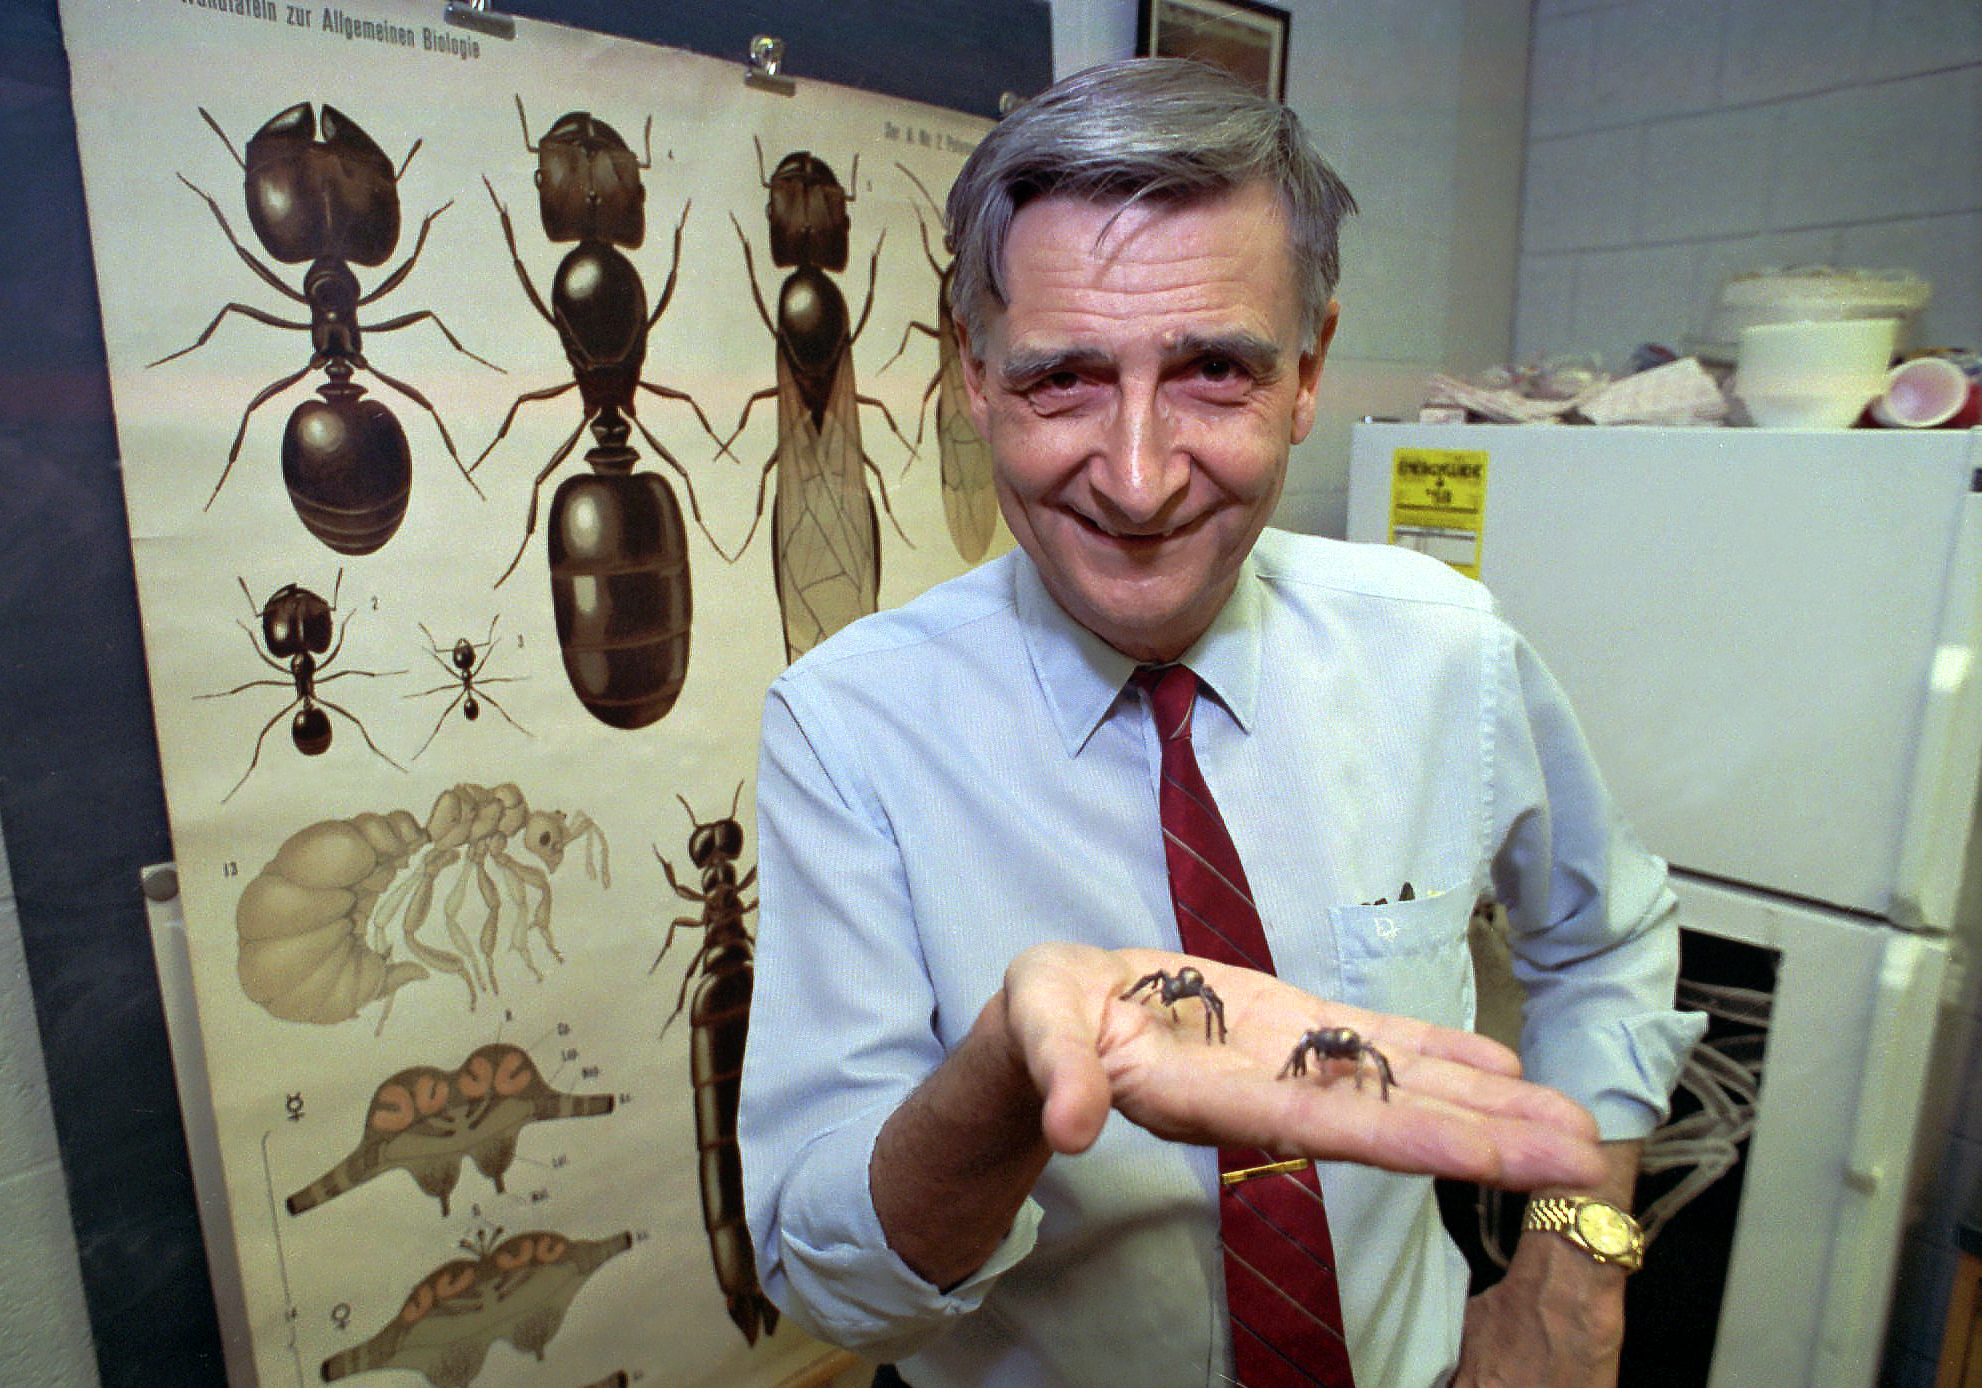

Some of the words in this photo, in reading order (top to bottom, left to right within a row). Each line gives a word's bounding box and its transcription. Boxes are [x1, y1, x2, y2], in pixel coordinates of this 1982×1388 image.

[286, 4, 311, 27] zur
[322, 6, 415, 47] Allgemeinen
[422, 27, 480, 60] Biologie
